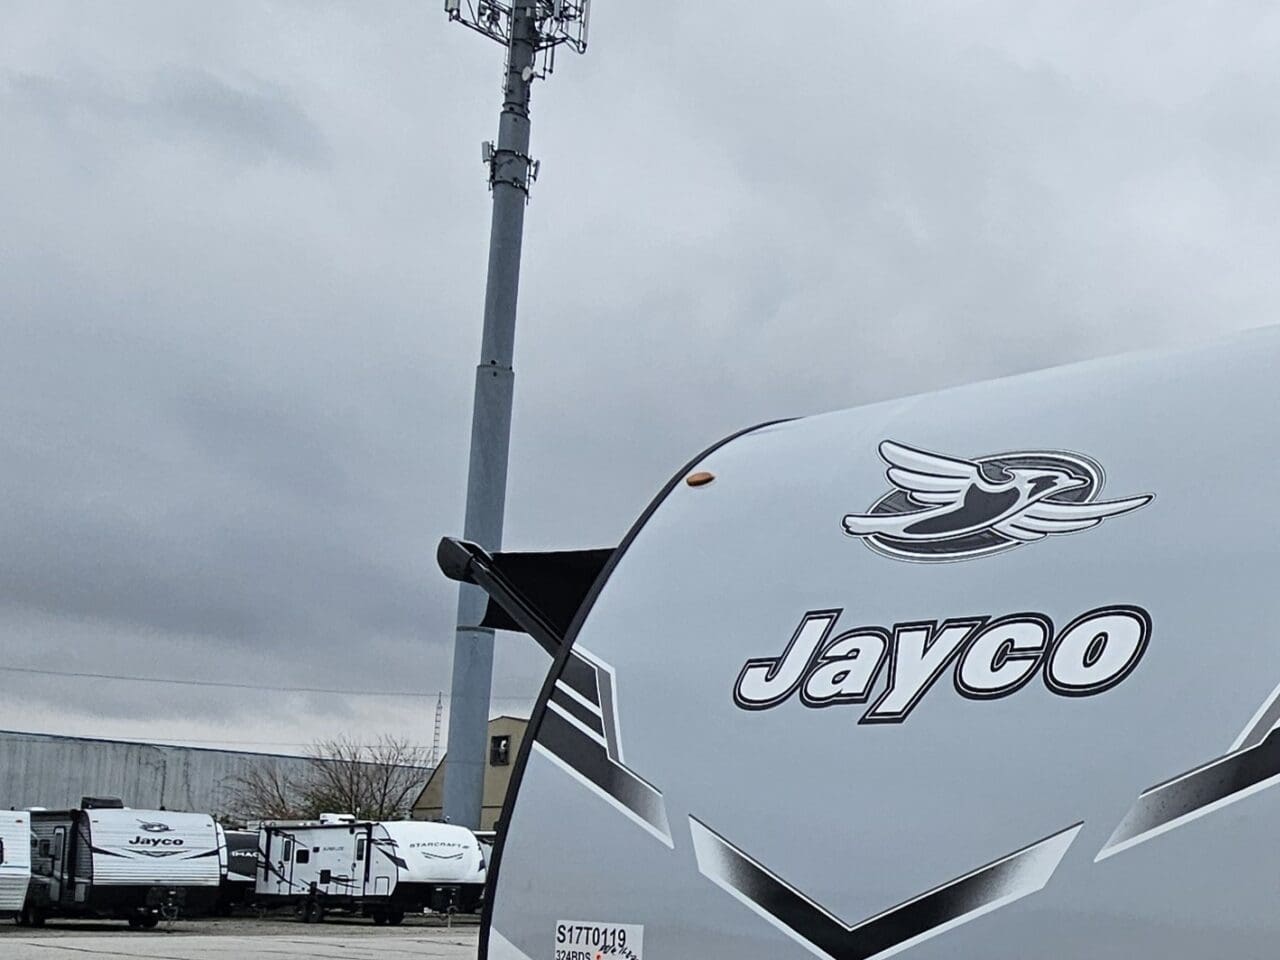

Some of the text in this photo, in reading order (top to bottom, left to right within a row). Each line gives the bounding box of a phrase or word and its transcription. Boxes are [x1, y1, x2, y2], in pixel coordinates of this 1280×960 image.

[733, 605, 1153, 725] Jayco
[128, 835, 184, 847] Jayco
[556, 924, 626, 948] S17T0119
